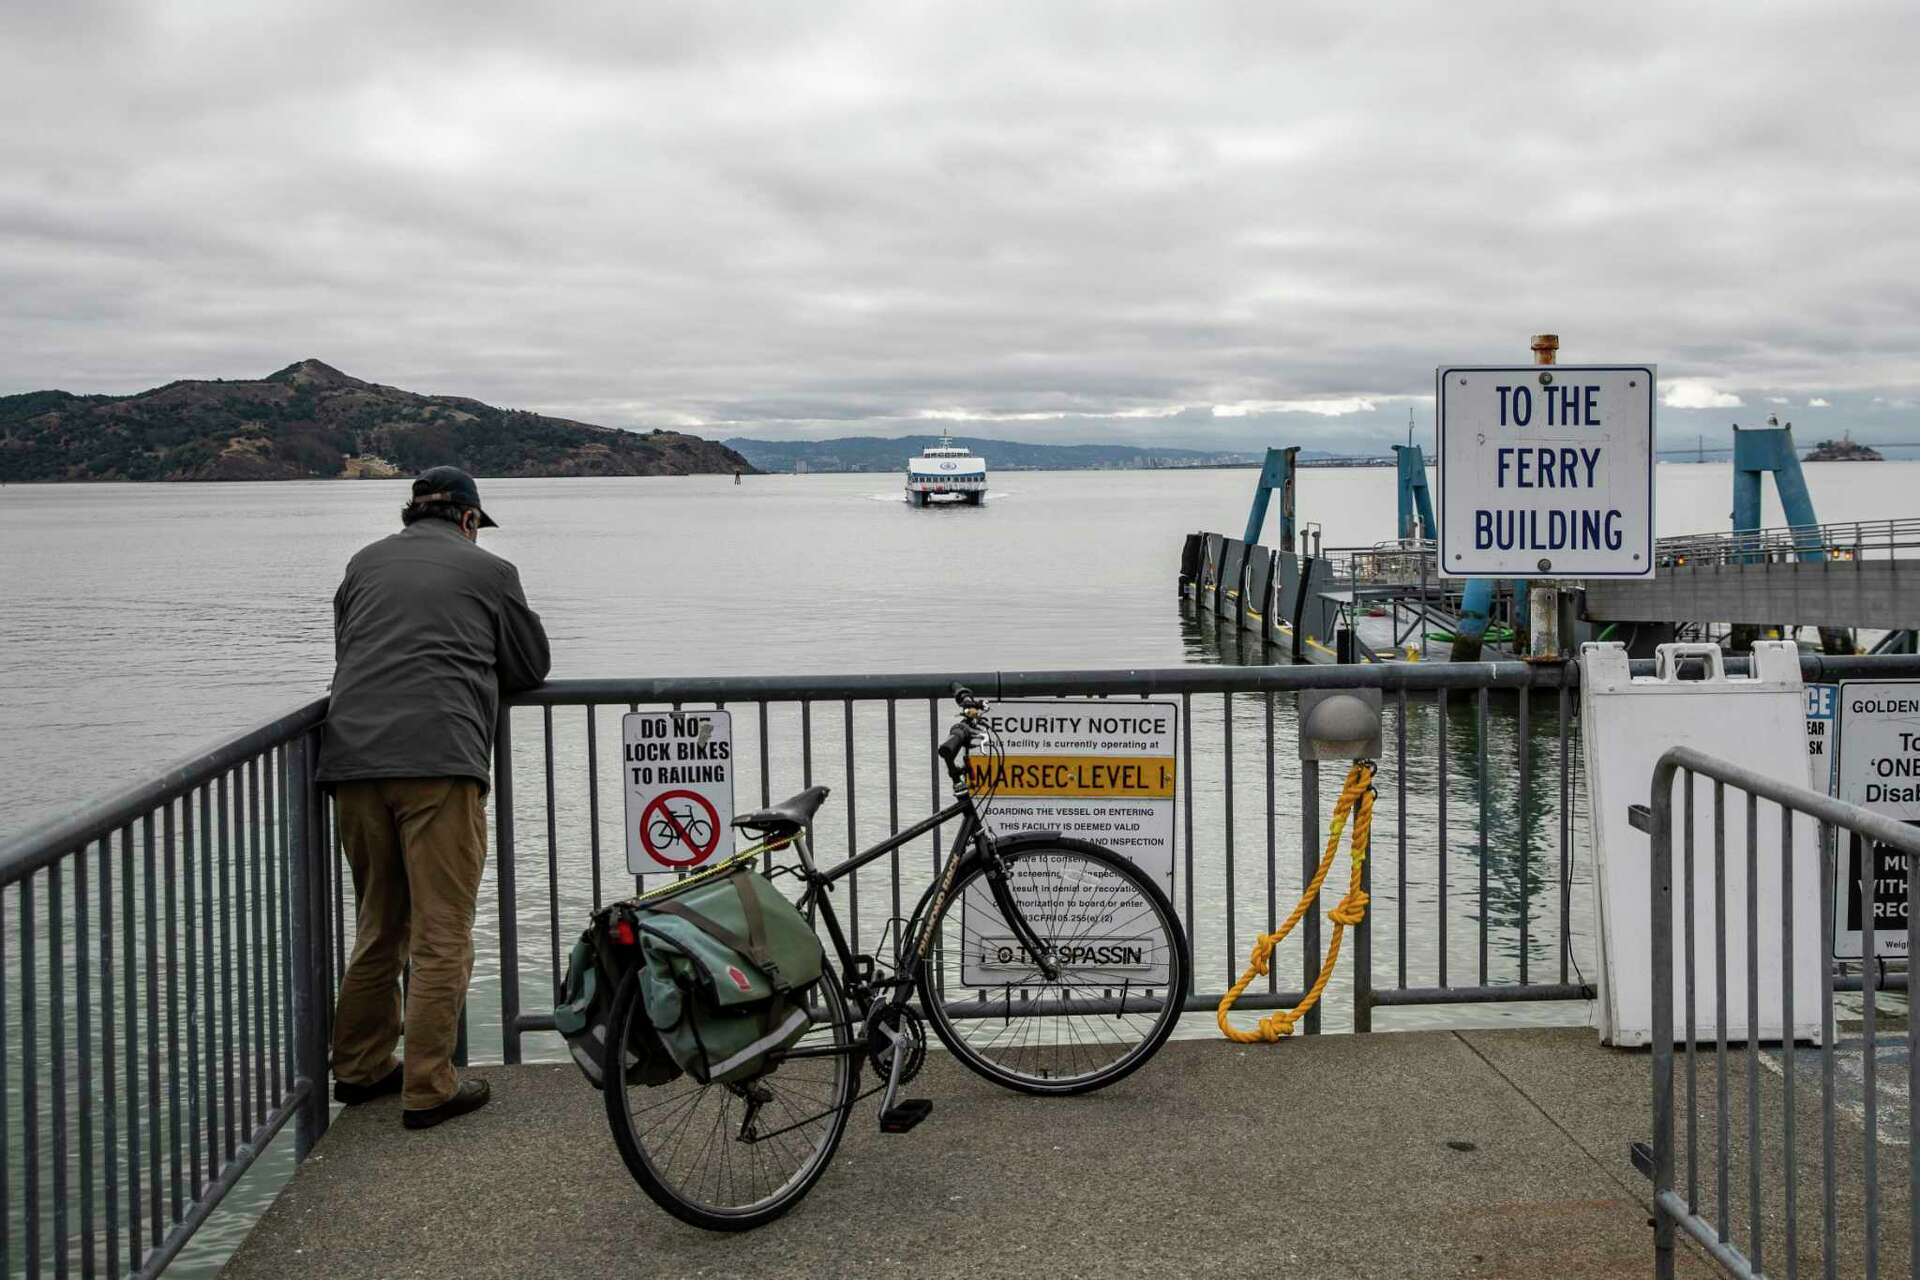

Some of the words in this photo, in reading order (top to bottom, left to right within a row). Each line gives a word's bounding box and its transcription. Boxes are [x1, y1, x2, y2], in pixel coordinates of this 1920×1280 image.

[1496, 386, 1532, 426] TO
[1543, 386, 1601, 426] THE
[1498, 448, 1601, 488] FERRY
[1475, 510, 1622, 550] BUILDING
[1852, 700, 1919, 713] GOLDEN
[641, 719, 667, 738] DO
[1088, 718, 1166, 734] NOTICE
[1807, 721, 1824, 735] EAR
[626, 743, 671, 761] LOCK
[677, 741, 729, 760] BIKES
[1006, 739, 1040, 749] facility
[1043, 740, 1051, 748] is
[1054, 740, 1097, 750] currently
[1101, 741, 1146, 750] operating
[1150, 741, 1159, 749] at
[632, 767, 652, 784] TO
[658, 765, 724, 784] RAILING
[976, 765, 1068, 788] MARSEC
[1078, 766, 1149, 788] LEVEL
[986, 808, 1033, 816] BOARDING
[1036, 808, 1054, 816] THE
[1056, 808, 1091, 816] VESSEL
[1093, 808, 1106, 816] OR
[1109, 808, 1154, 816] ENTERING
[1000, 822, 1019, 830] THIS
[1074, 823, 1111, 831] DEEMED
[1114, 823, 1140, 831] VALID
[1110, 838, 1164, 846] INSPECTION
